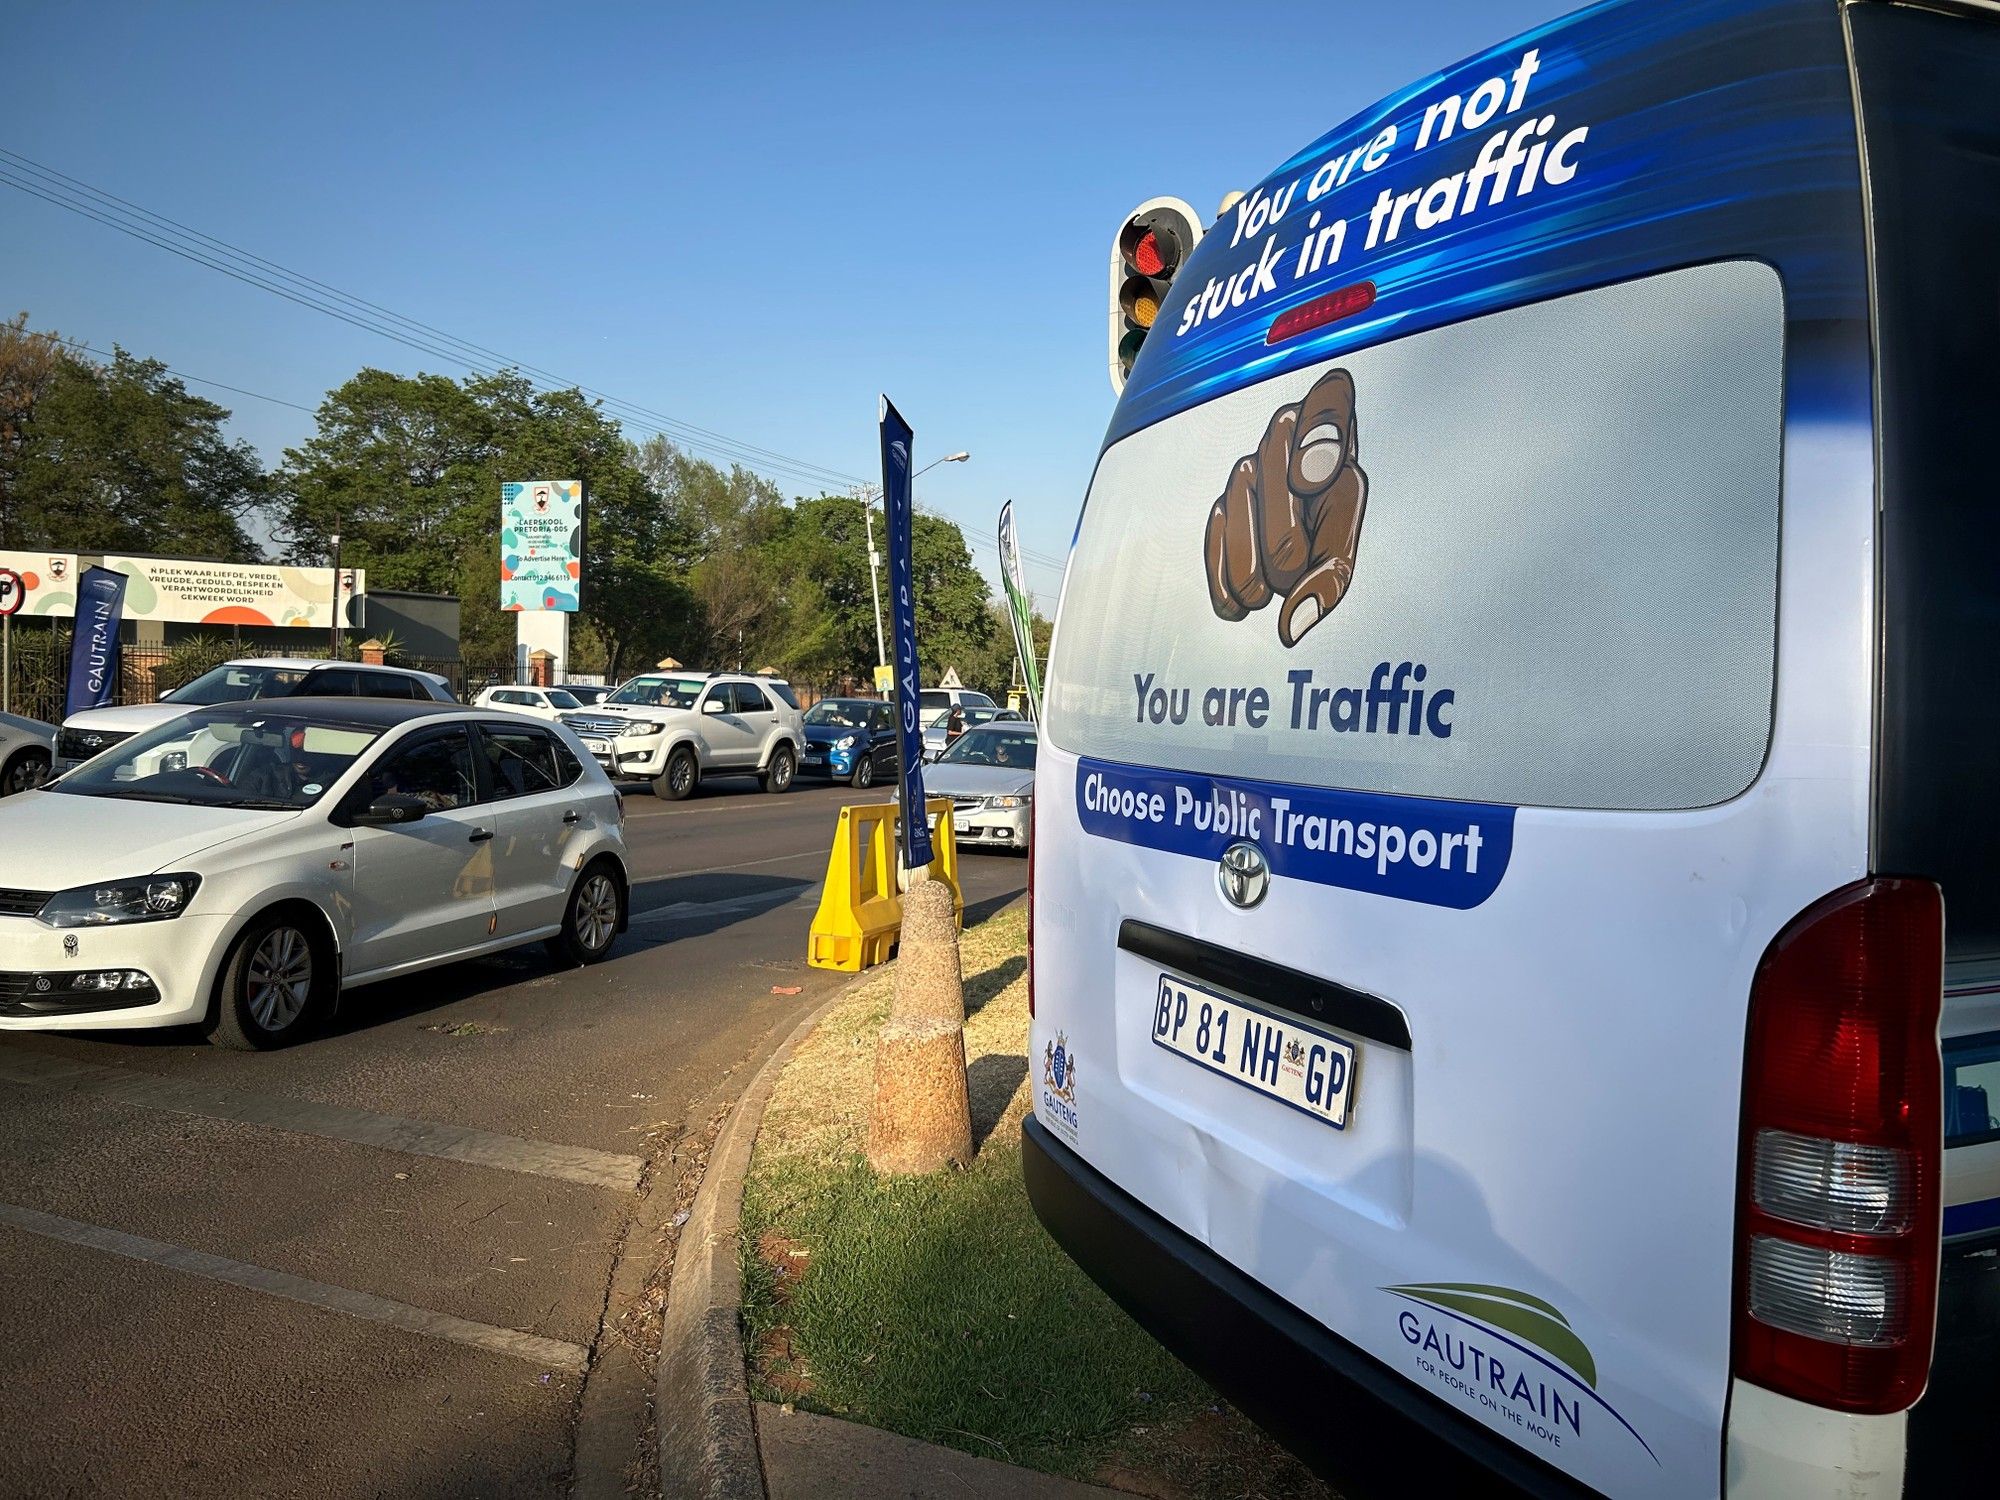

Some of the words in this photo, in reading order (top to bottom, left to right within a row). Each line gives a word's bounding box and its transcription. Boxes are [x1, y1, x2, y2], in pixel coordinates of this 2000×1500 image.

[1230, 178, 1300, 249] You
[1307, 123, 1399, 202] are
[1414, 48, 1541, 151] not
[1176, 233, 1288, 337] stuck
[1294, 210, 1348, 279] in
[1364, 114, 1590, 251] traffic
[149, 576, 195, 585] VREUGDE,
[196, 578, 235, 587] GEDULD,
[237, 580, 270, 588] RESPEK
[162, 585, 274, 596] VERANTWOORDELIKHEID
[181, 594, 225, 602] GEKWEEK
[214, 571, 247, 579] LIEFDE,
[249, 573, 280, 581] VREDE,
[88, 600, 111, 692] GAUTRAIN
[1134, 673, 1190, 725] You
[1202, 687, 1270, 729] are
[1287, 661, 1455, 739] Traffic
[1084, 772, 1165, 824] Choose
[1175, 785, 1262, 841] Public
[1270, 797, 1484, 876] Transport
[1157, 986, 1188, 1042] BP
[1196, 1002, 1229, 1064] 81
[1240, 1018, 1283, 1086] NH
[1305, 1044, 1346, 1111] GP
[1043, 1091, 1078, 1128] GAUTENG
[1399, 1311, 1581, 1438] GAUTRAIN
[1416, 1356, 1435, 1376] FOR
[1439, 1369, 1475, 1400] PEOPLE
[1479, 1394, 1497, 1411] ON
[1501, 1405, 1522, 1426] THE
[1527, 1421, 1561, 1448] MOVE
